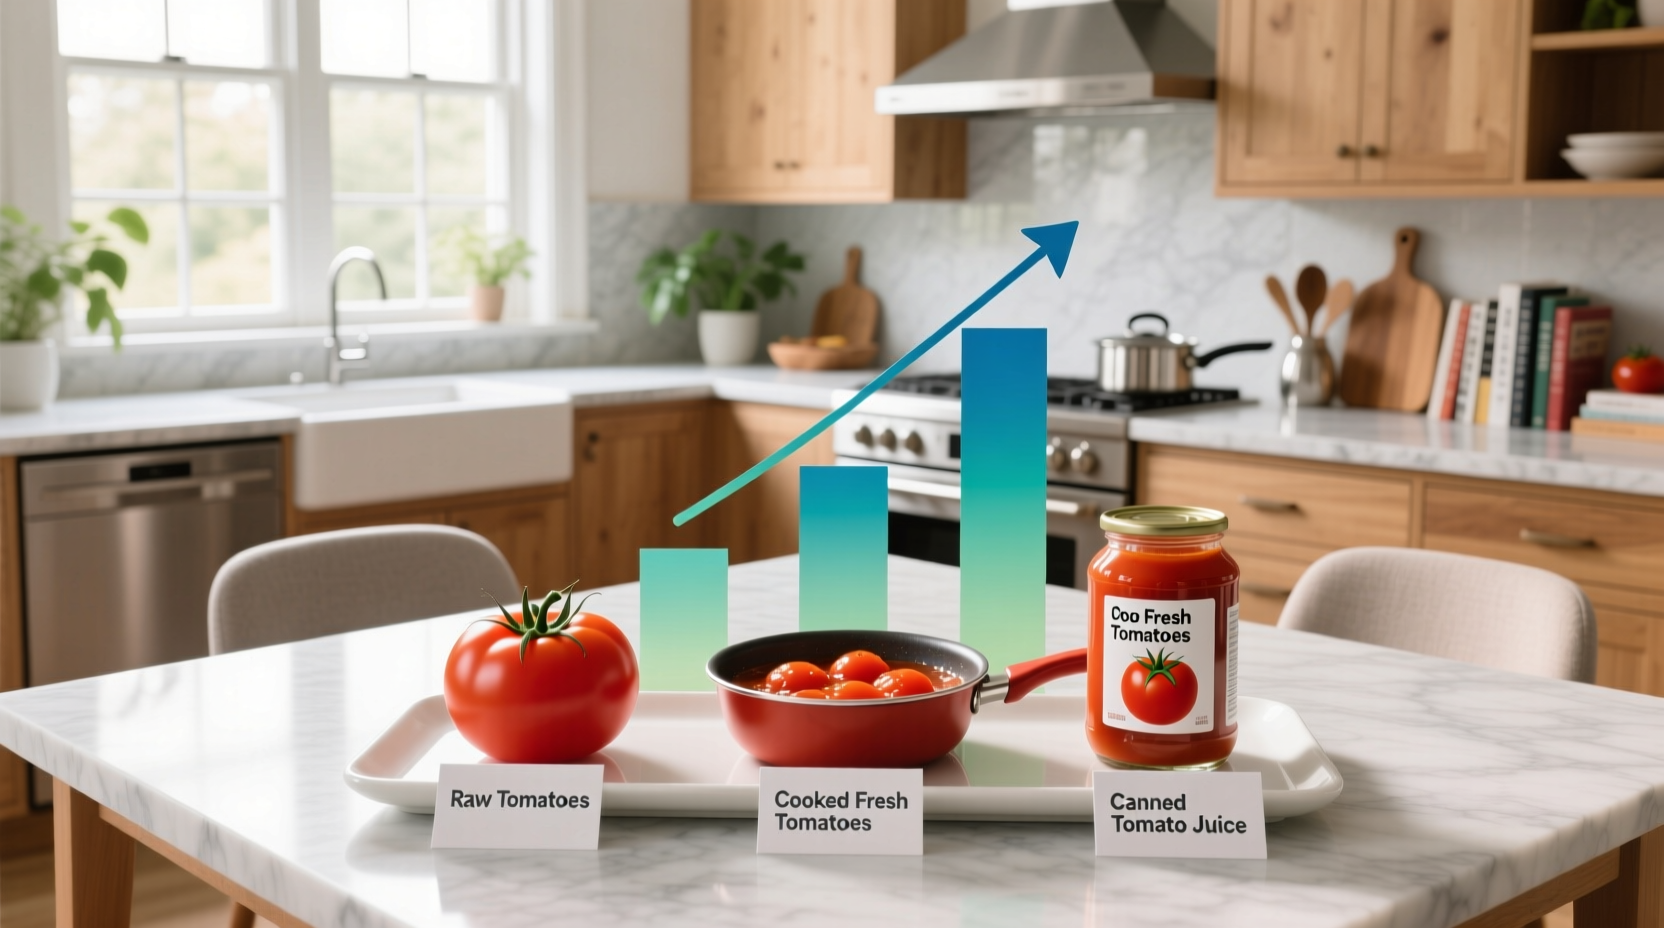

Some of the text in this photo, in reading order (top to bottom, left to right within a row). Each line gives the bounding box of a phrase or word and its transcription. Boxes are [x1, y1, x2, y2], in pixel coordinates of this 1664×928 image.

[1111, 605, 1192, 625] Coo Fresh
[1110, 624, 1192, 643] Tomatoes
[450, 789, 590, 809] Raw Tomatoes
[774, 789, 908, 810] Cooked Fresh
[1110, 792, 1187, 811] Canned
[774, 812, 872, 832] Tomatoes
[1110, 814, 1248, 834] Tomato Juice
